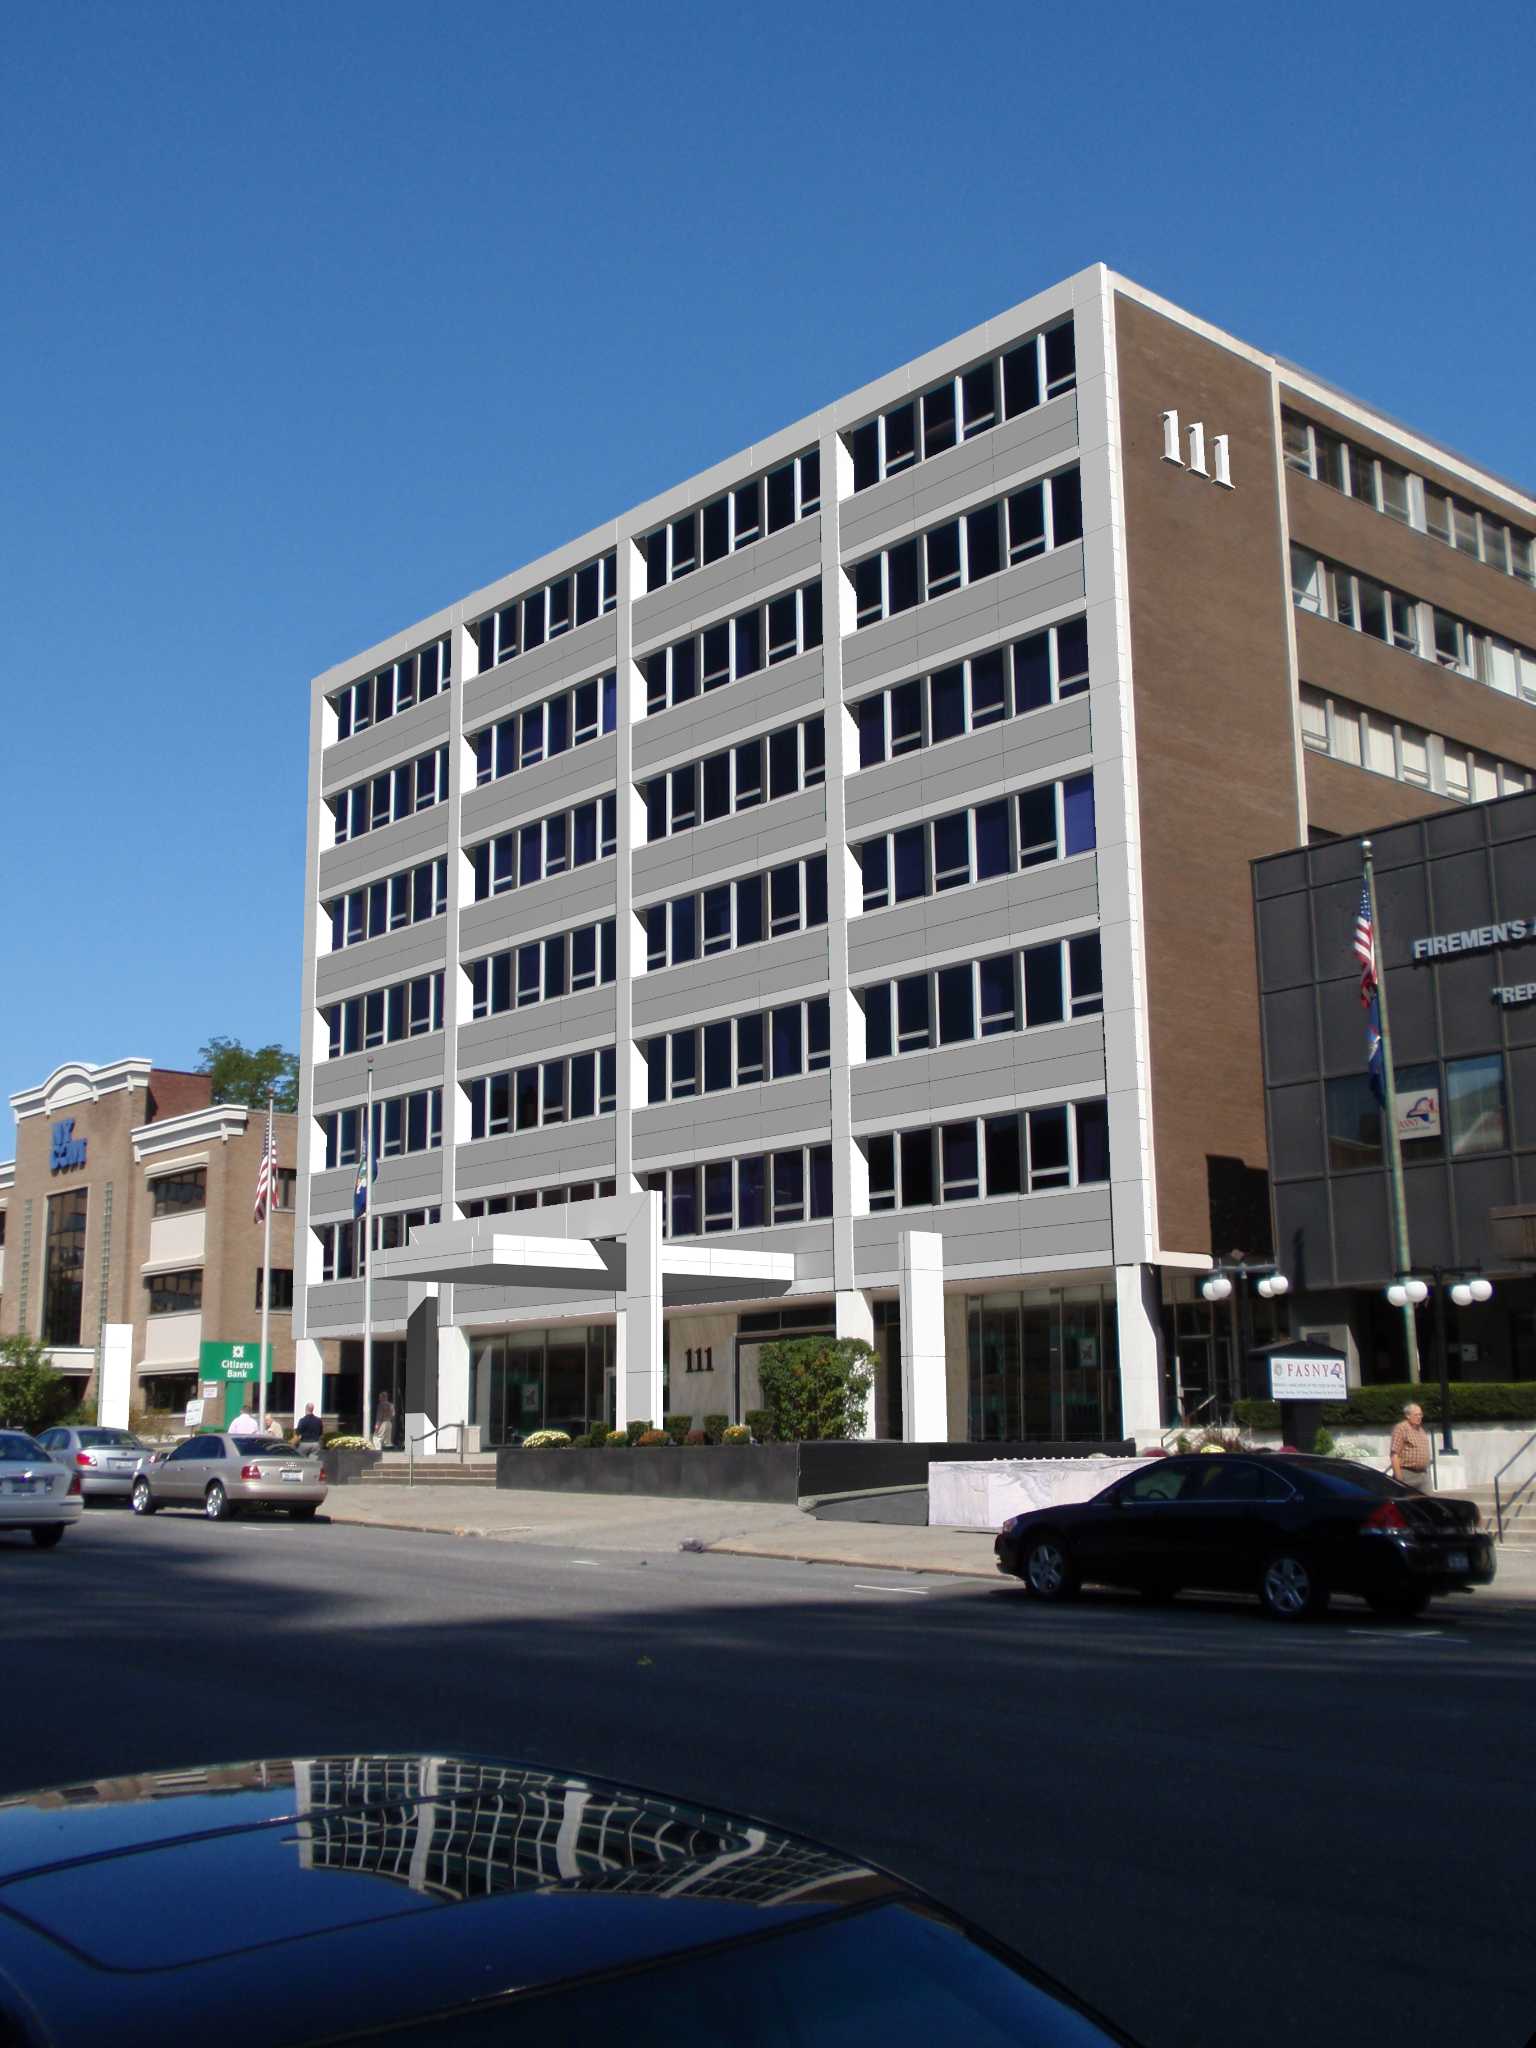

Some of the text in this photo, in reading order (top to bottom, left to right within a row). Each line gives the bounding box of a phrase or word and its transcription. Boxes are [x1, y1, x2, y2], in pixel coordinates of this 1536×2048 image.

[1160, 410, 1235, 490] 111
[1414, 920, 1527, 959] FIREMEN'S
[221, 1360, 254, 1369] Citizens
[685, 1346, 714, 1373] 111
[227, 1370, 247, 1378] Bank
[1287, 1363, 1329, 1377] FASNY
